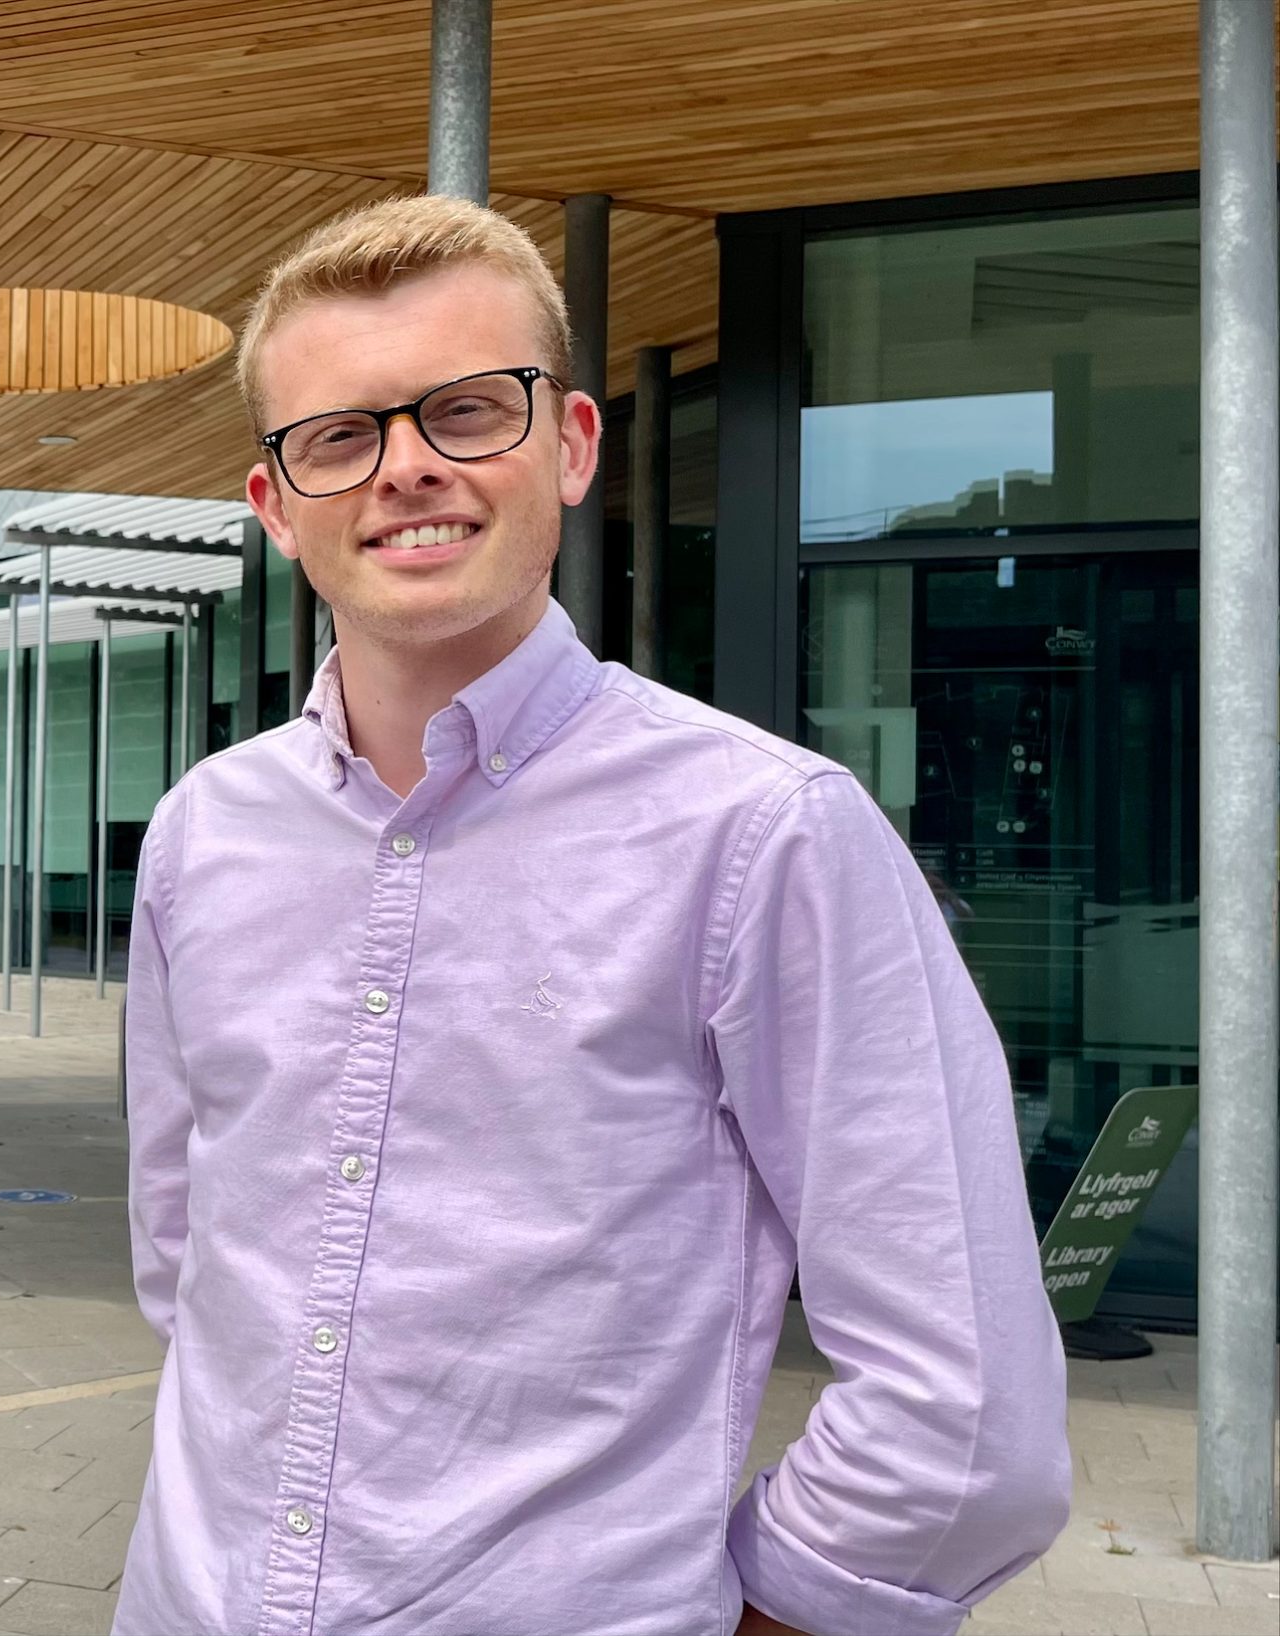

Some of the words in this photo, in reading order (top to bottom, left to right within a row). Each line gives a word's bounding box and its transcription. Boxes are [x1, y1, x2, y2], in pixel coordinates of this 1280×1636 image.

[1078, 1168, 1160, 1198] Llyfrgell
[1070, 1202, 1095, 1219] ar
[1094, 1198, 1140, 1220] agor
[1044, 1245, 1114, 1267] Library
[1045, 1271, 1091, 1293] open
